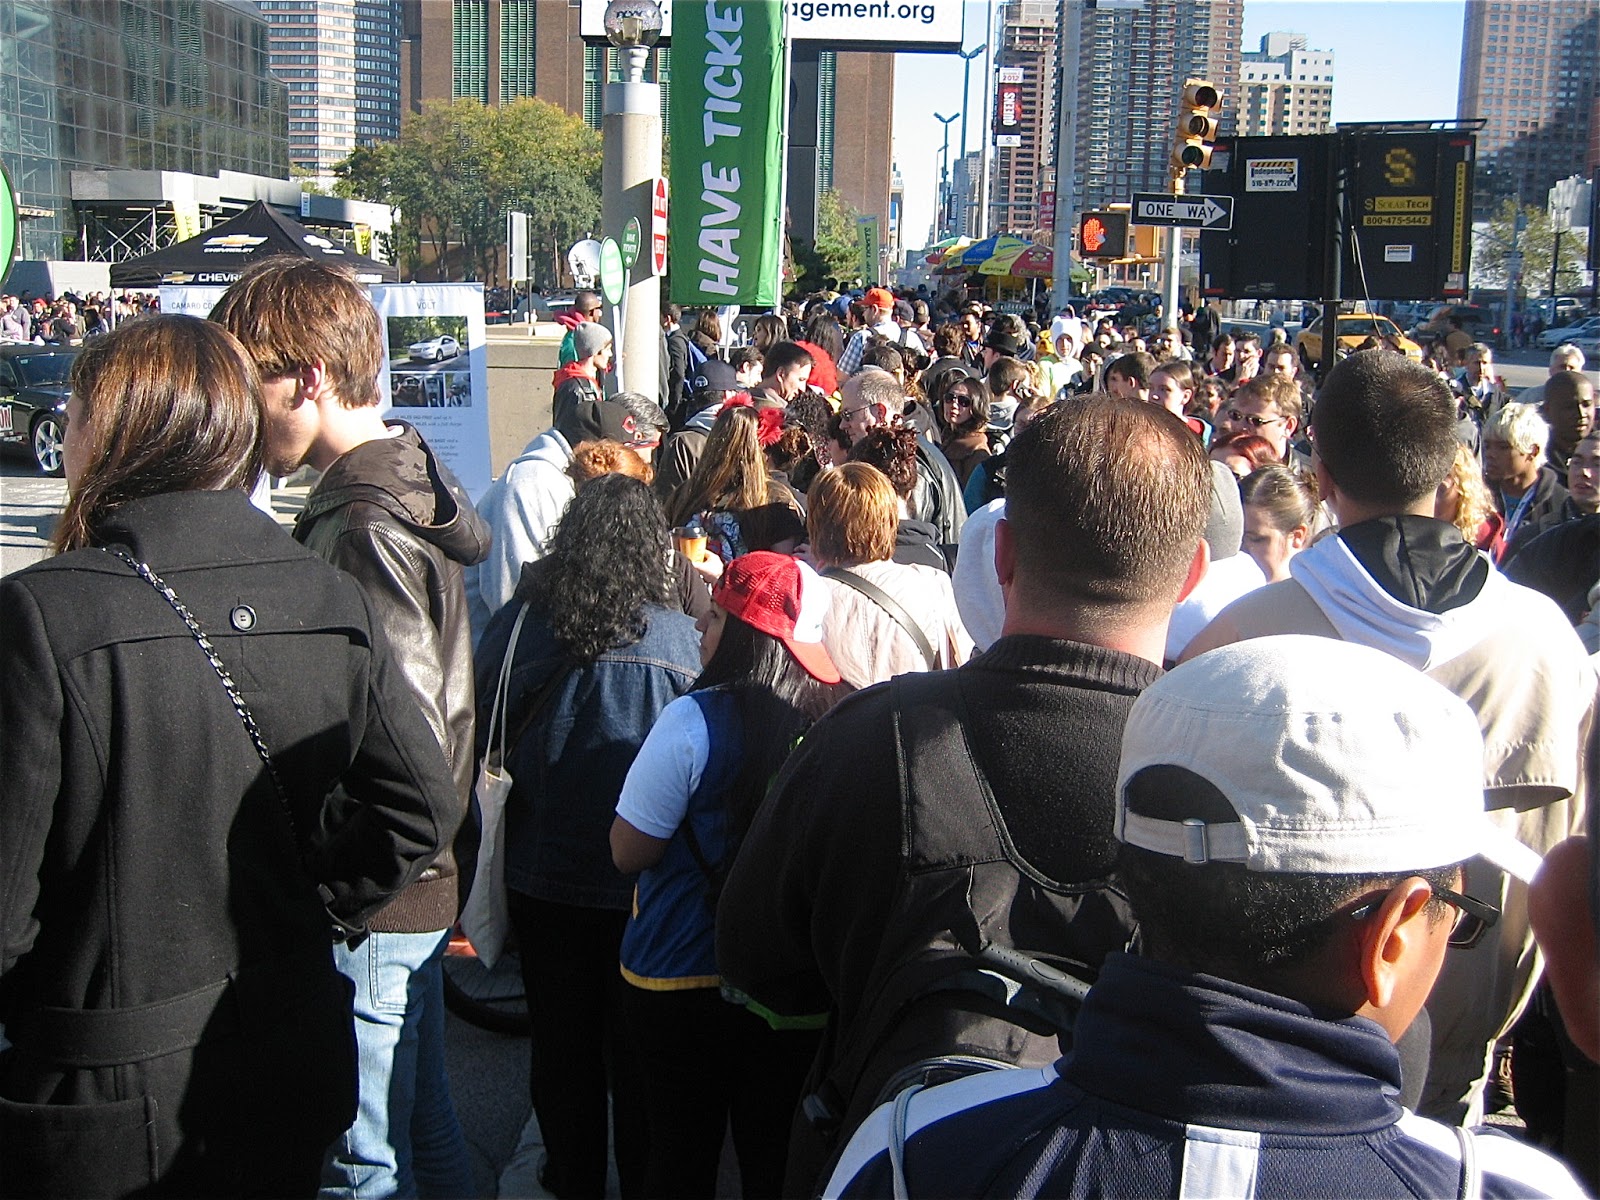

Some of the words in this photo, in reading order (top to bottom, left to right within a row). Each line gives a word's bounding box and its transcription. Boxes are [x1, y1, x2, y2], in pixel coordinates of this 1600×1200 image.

[1002, 92, 1017, 126] QUEENS
[1146, 203, 1174, 216] ONE
[1187, 205, 1217, 219] WAY
[1366, 216, 1428, 225] 800-475-5442
[698, 160, 742, 297] HAVE
[171, 302, 201, 310] CAMARO
[417, 301, 436, 310] VOLT
